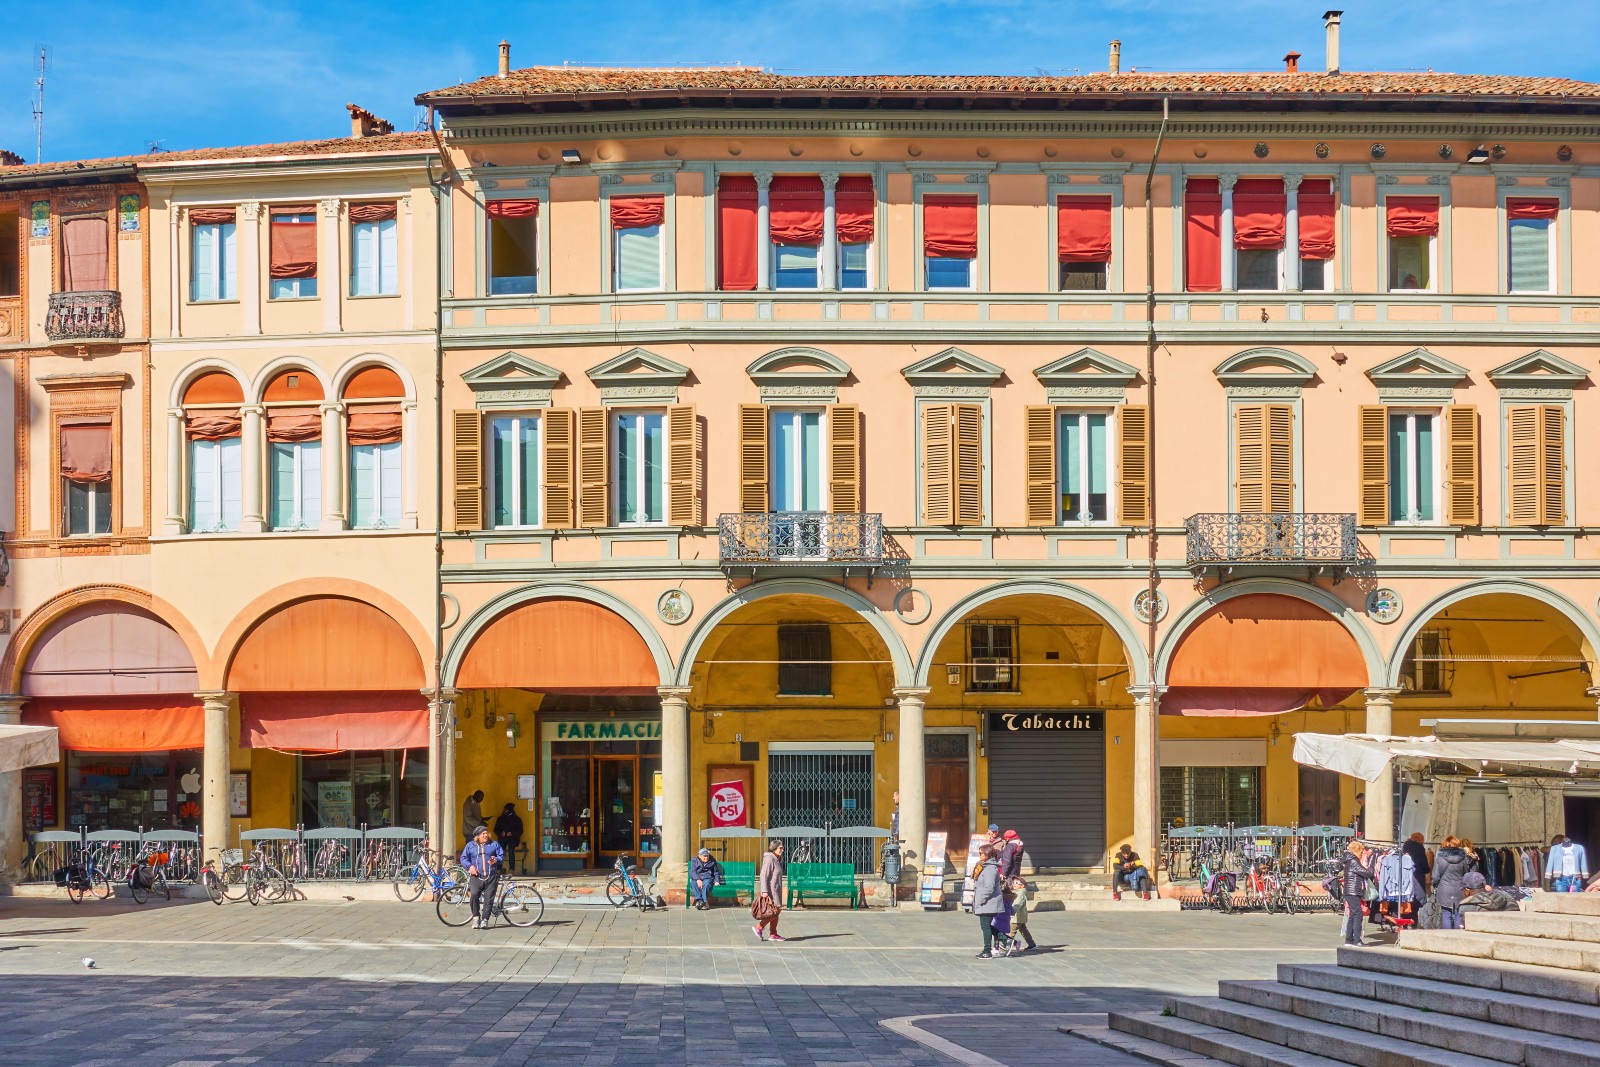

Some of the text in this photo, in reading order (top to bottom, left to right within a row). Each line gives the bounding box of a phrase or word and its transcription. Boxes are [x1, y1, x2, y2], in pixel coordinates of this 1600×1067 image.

[1001, 713, 1091, 731] Tabacchi
[557, 723, 662, 739] FARMACIA
[718, 804, 739, 818] PSI
